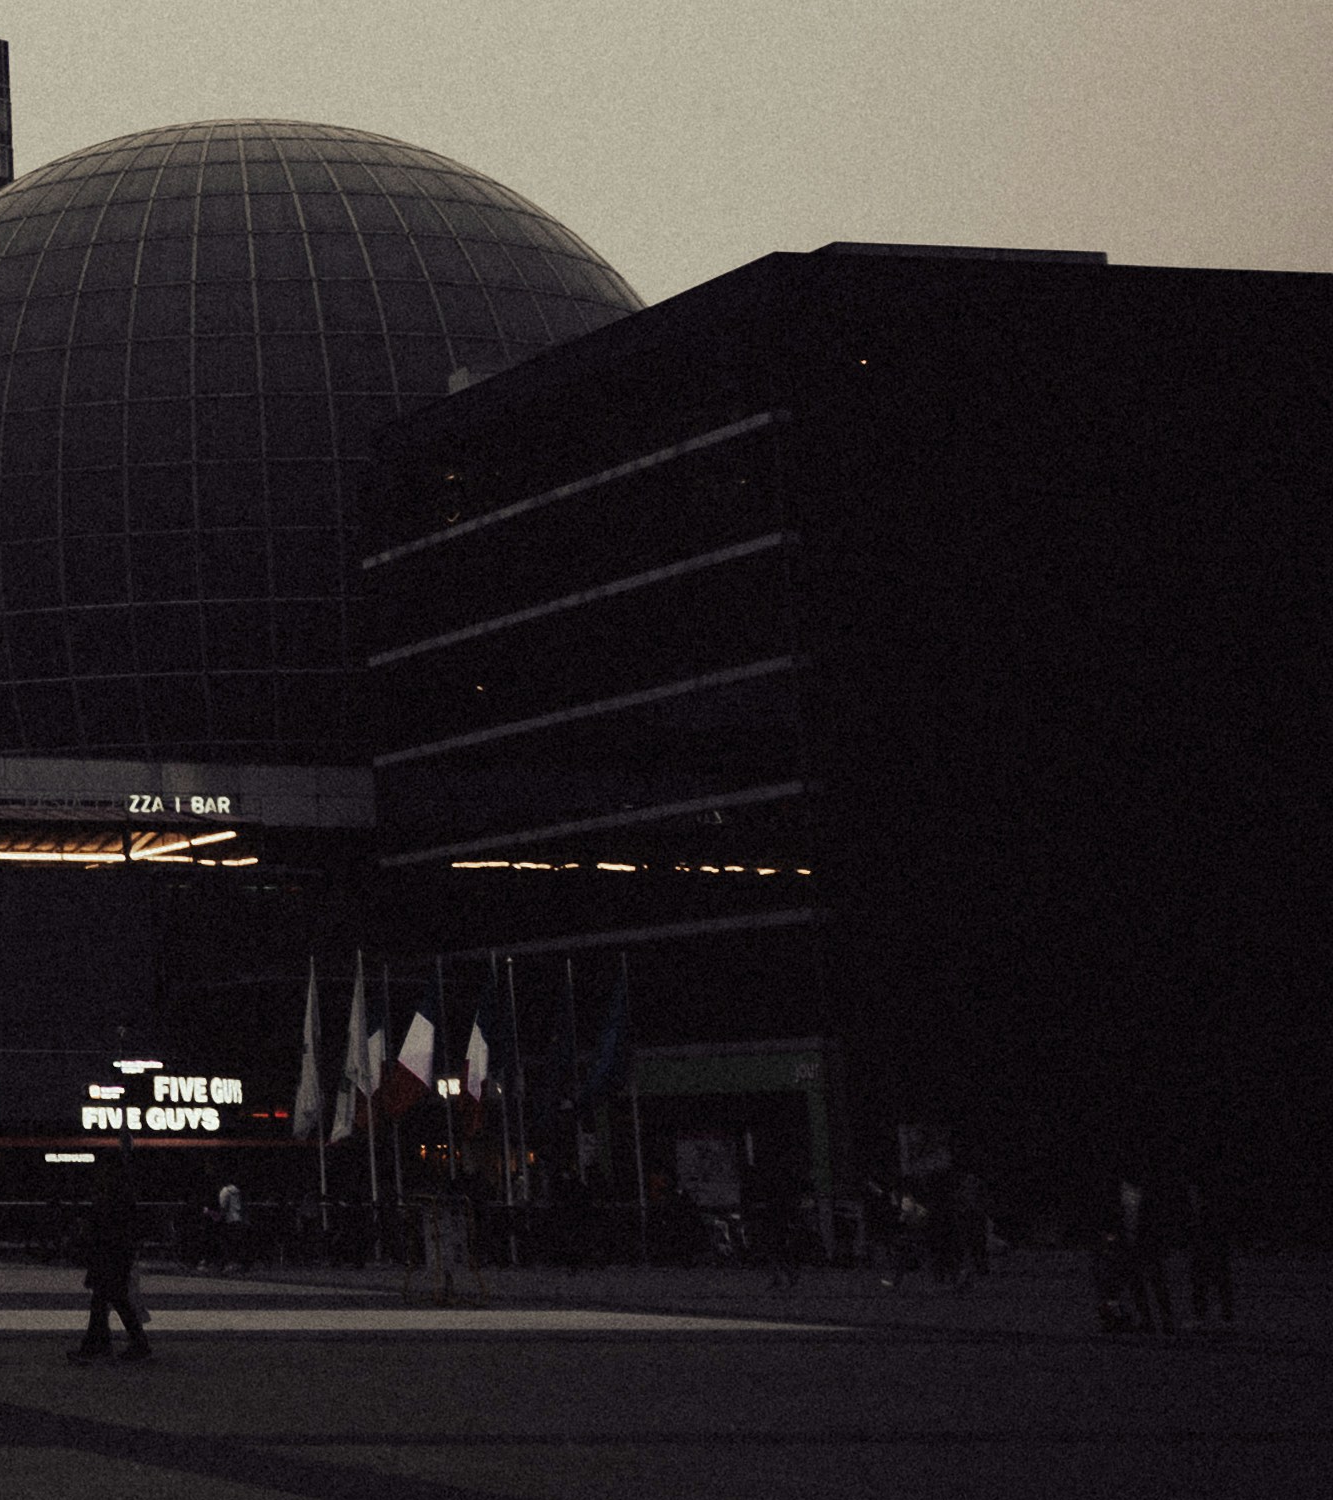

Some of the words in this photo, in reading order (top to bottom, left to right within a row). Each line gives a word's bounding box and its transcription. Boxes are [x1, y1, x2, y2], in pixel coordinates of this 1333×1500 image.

[190, 795, 231, 814] BAR
[154, 1076, 209, 1103] FIVE
[82, 1107, 142, 1130] FIVE
[145, 1107, 220, 1131] GUYS
